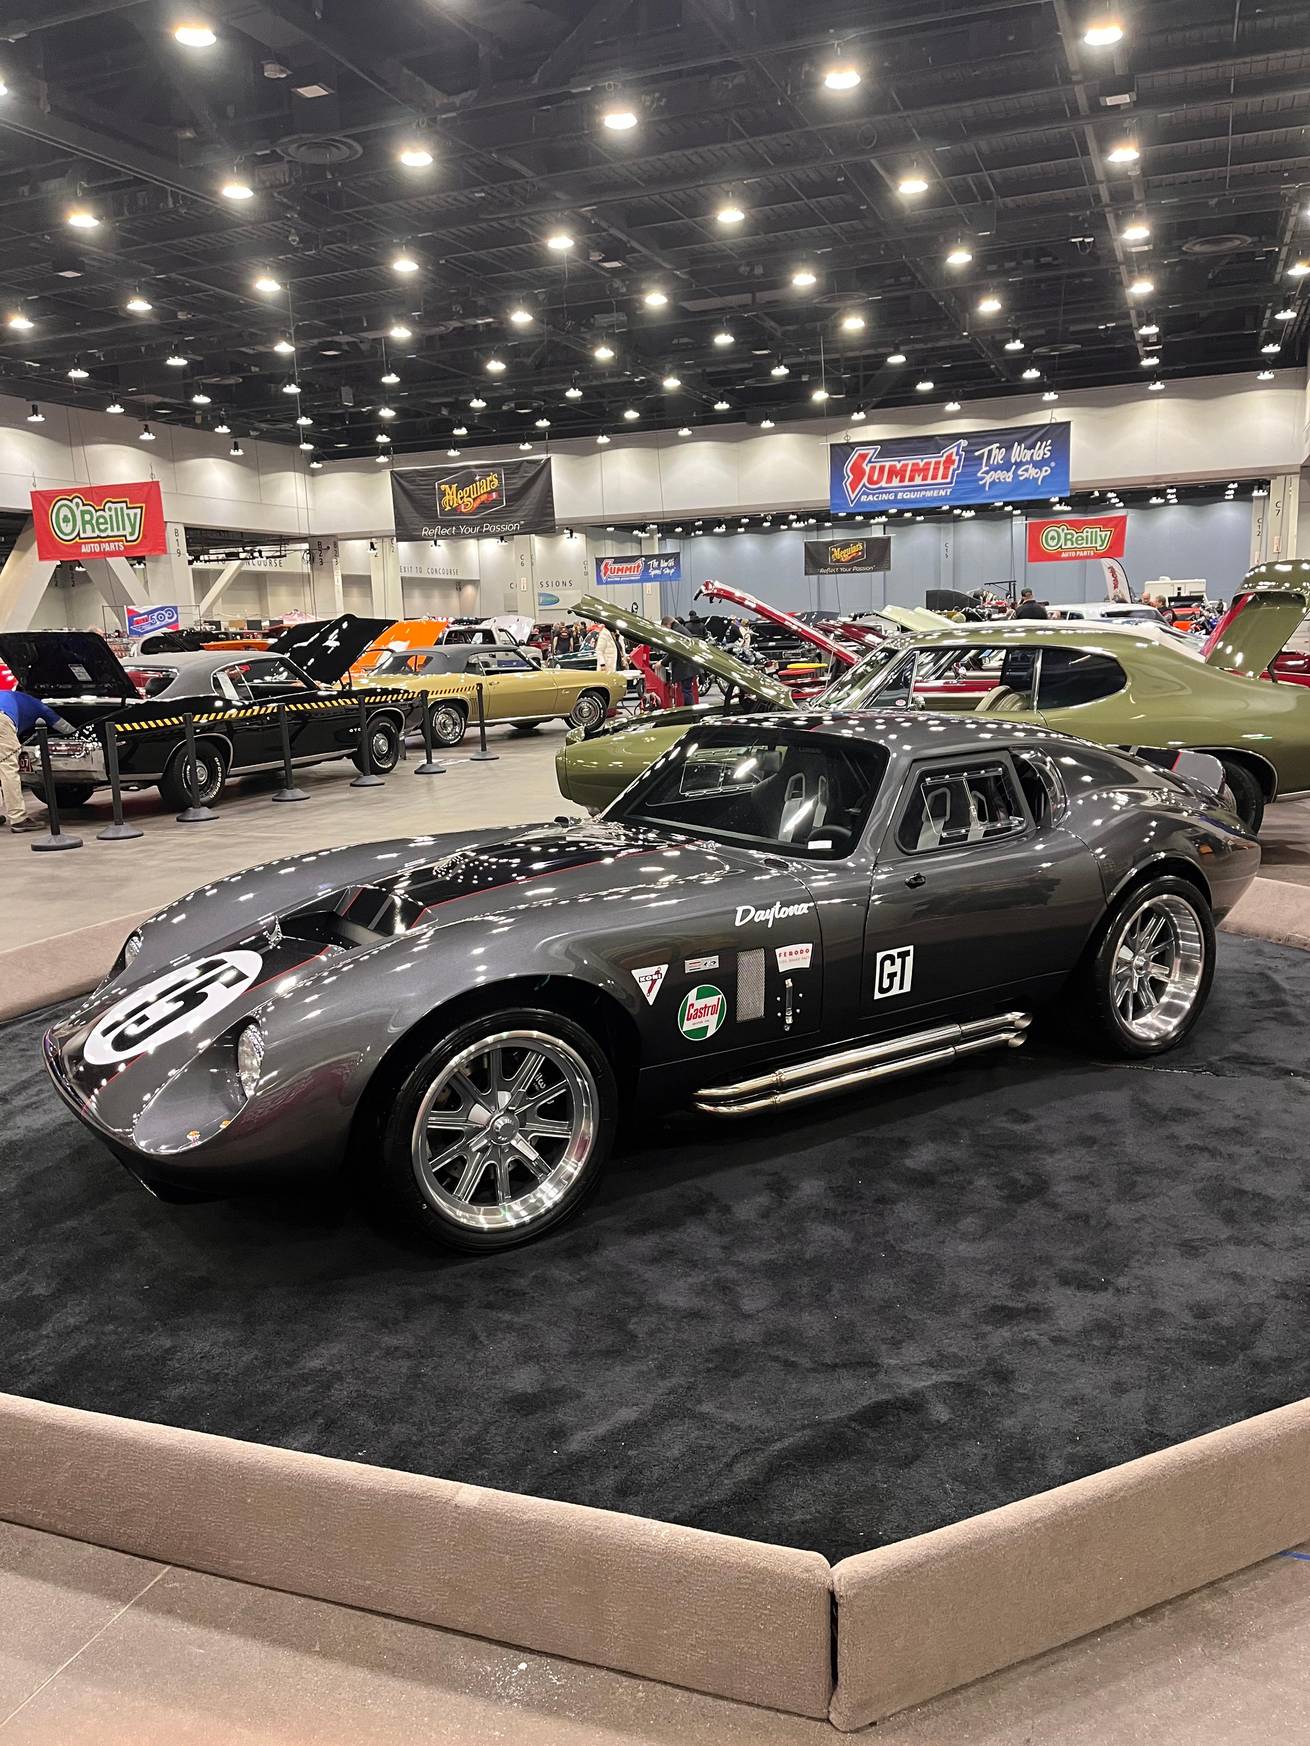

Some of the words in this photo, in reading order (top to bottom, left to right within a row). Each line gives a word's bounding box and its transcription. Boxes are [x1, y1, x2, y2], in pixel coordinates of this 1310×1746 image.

[974, 442, 1006, 469] The
[1010, 439, 1052, 464] World's
[977, 464, 1016, 491] Speed
[1017, 463, 1051, 485] Shop
[440, 472, 499, 512] Meguiar's
[861, 492, 895, 502] RACING
[897, 488, 953, 500] EQUIPMENT
[54, 501, 138, 537] O'Reilly
[421, 525, 456, 538] Reflect
[459, 525, 481, 534] Your
[482, 522, 520, 533] Passion
[81, 543, 100, 553] AUTO
[100, 542, 125, 552] PARTS
[1043, 526, 1108, 548] O'Reilly
[1061, 550, 1076, 558] AUTO
[1076, 549, 1094, 557] PARTS
[734, 901, 815, 928] Daytona
[639, 973, 662, 983] KONI
[877, 949, 911, 995] GT
[686, 997, 721, 1022] Castrol
